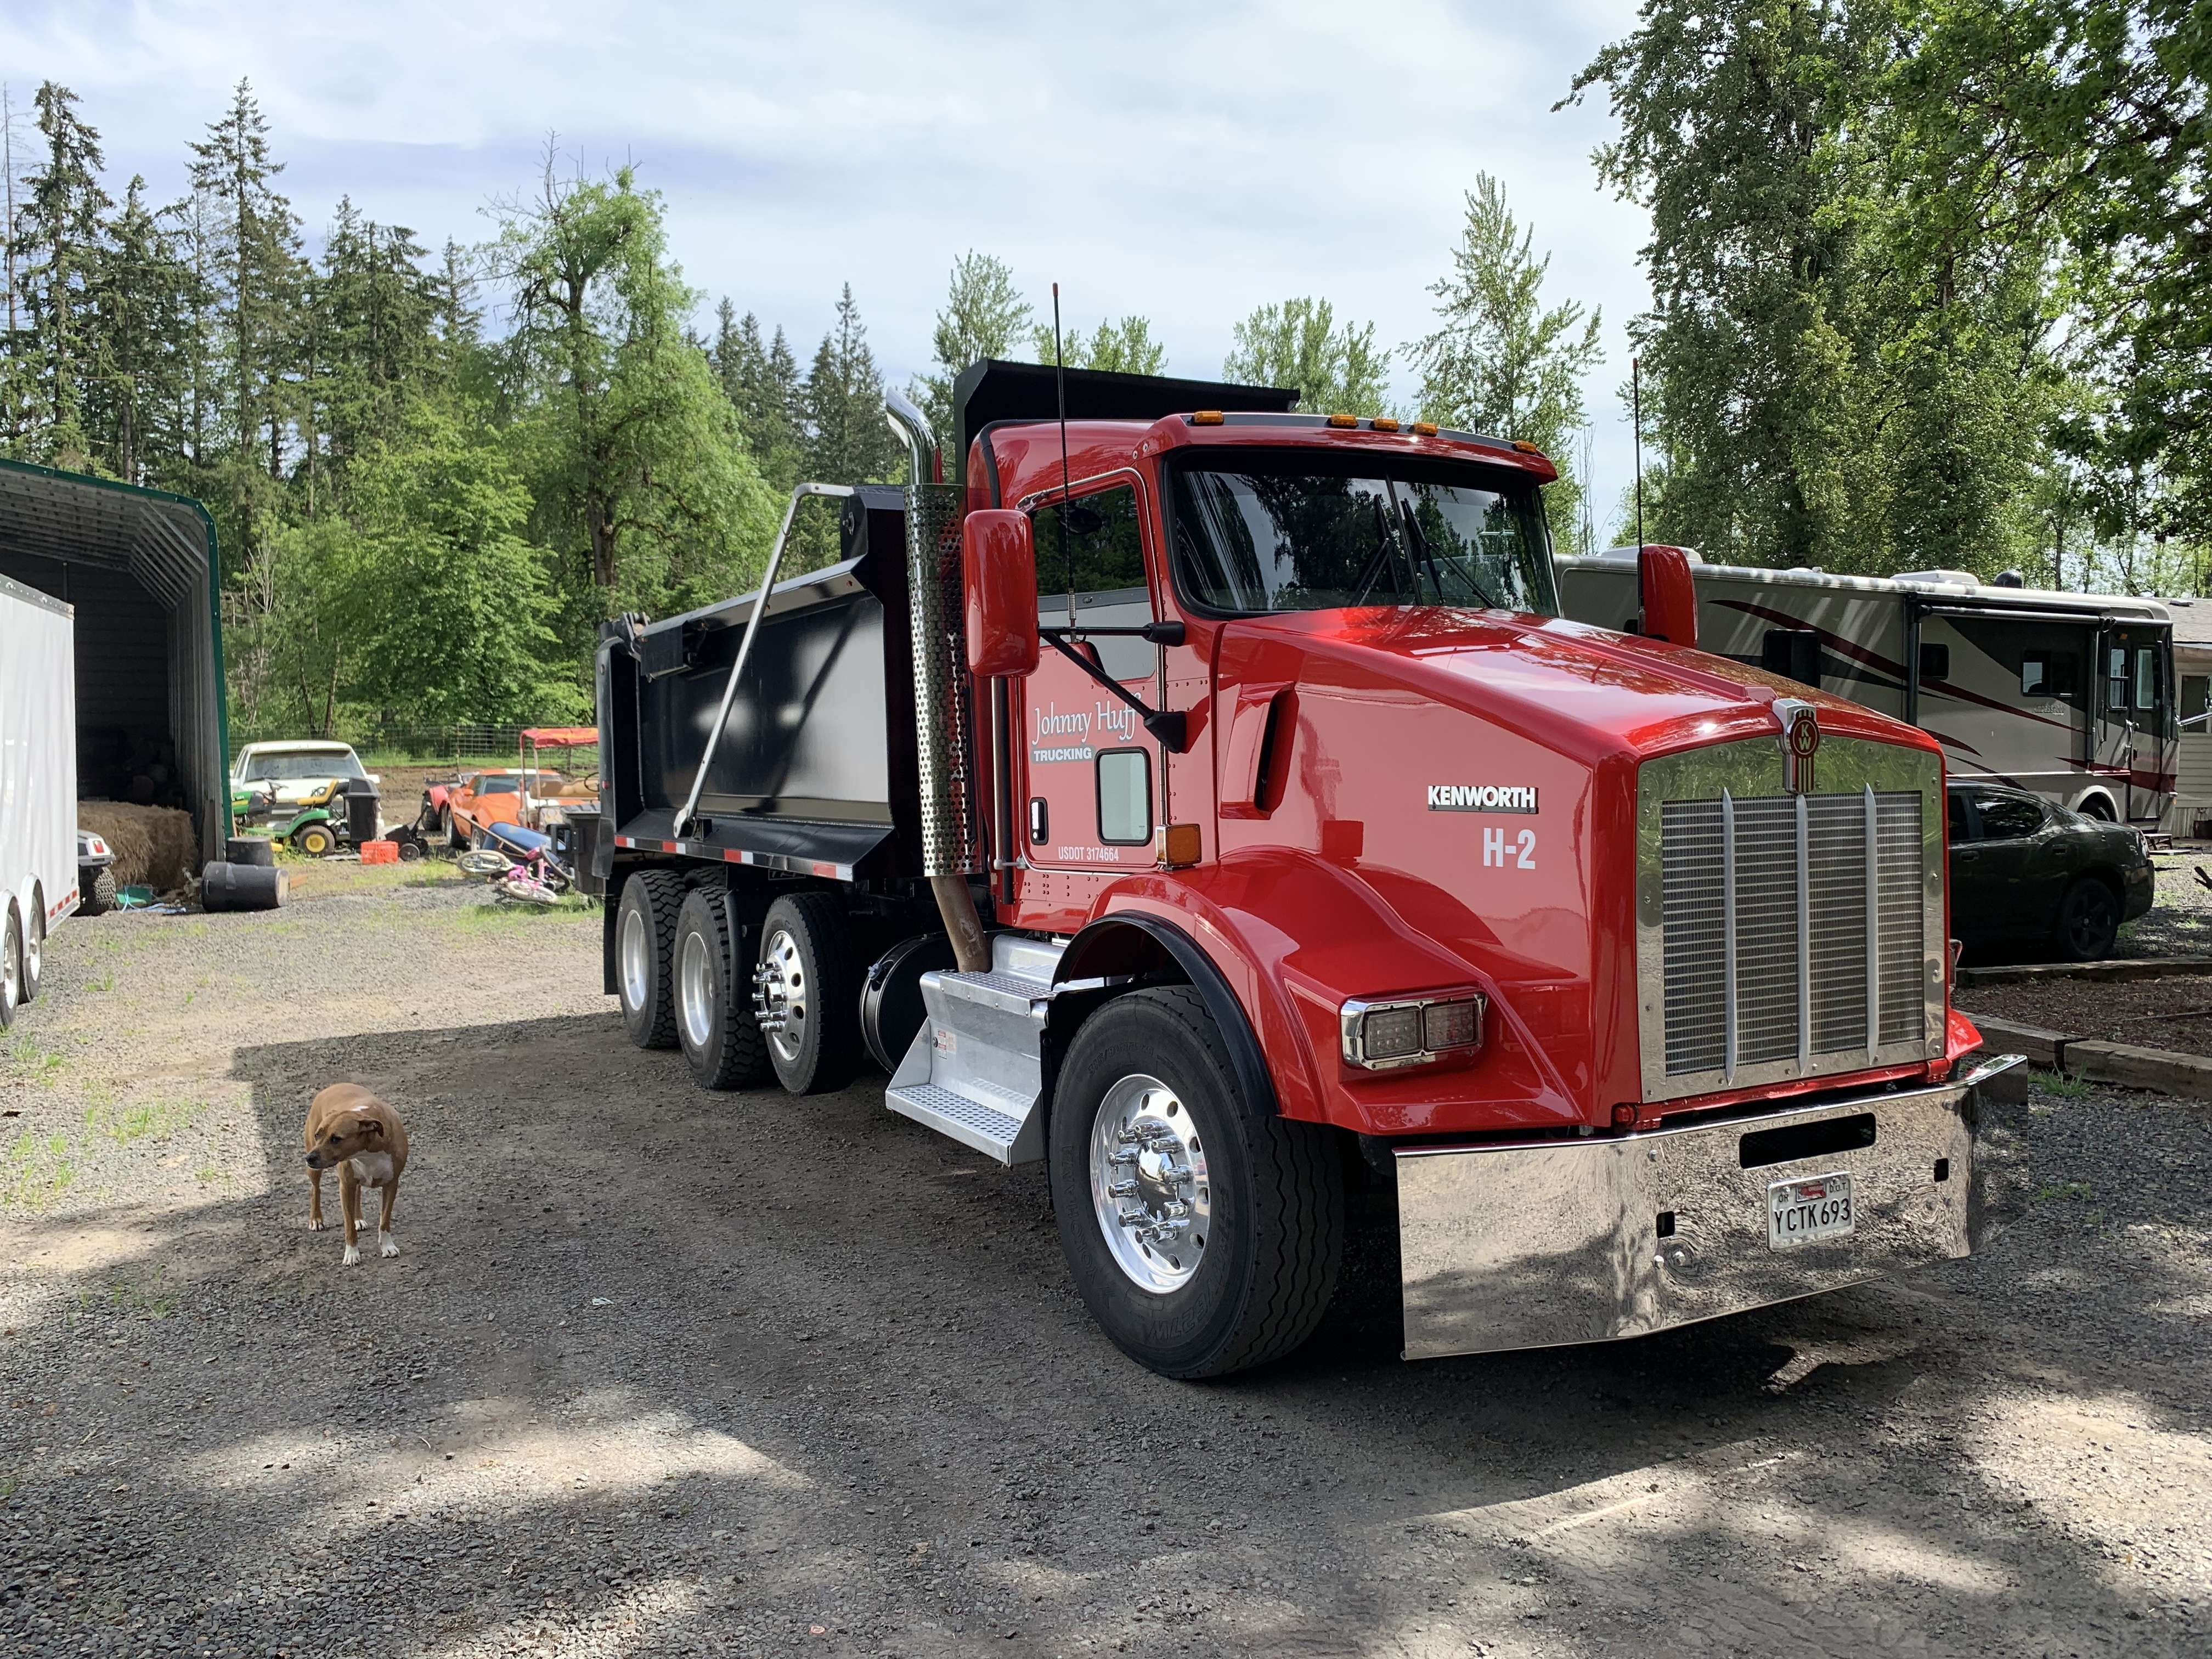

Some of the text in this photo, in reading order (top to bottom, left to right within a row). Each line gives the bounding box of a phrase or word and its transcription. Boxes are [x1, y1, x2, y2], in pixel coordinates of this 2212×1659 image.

[1032, 692, 1142, 745] Johnny Huff
[1034, 747, 1092, 761] TRUCKING
[1428, 786, 1536, 808] KENWORTH
[1058, 846, 1119, 861] USDOT 3174664
[1483, 827, 1536, 870] H-2
